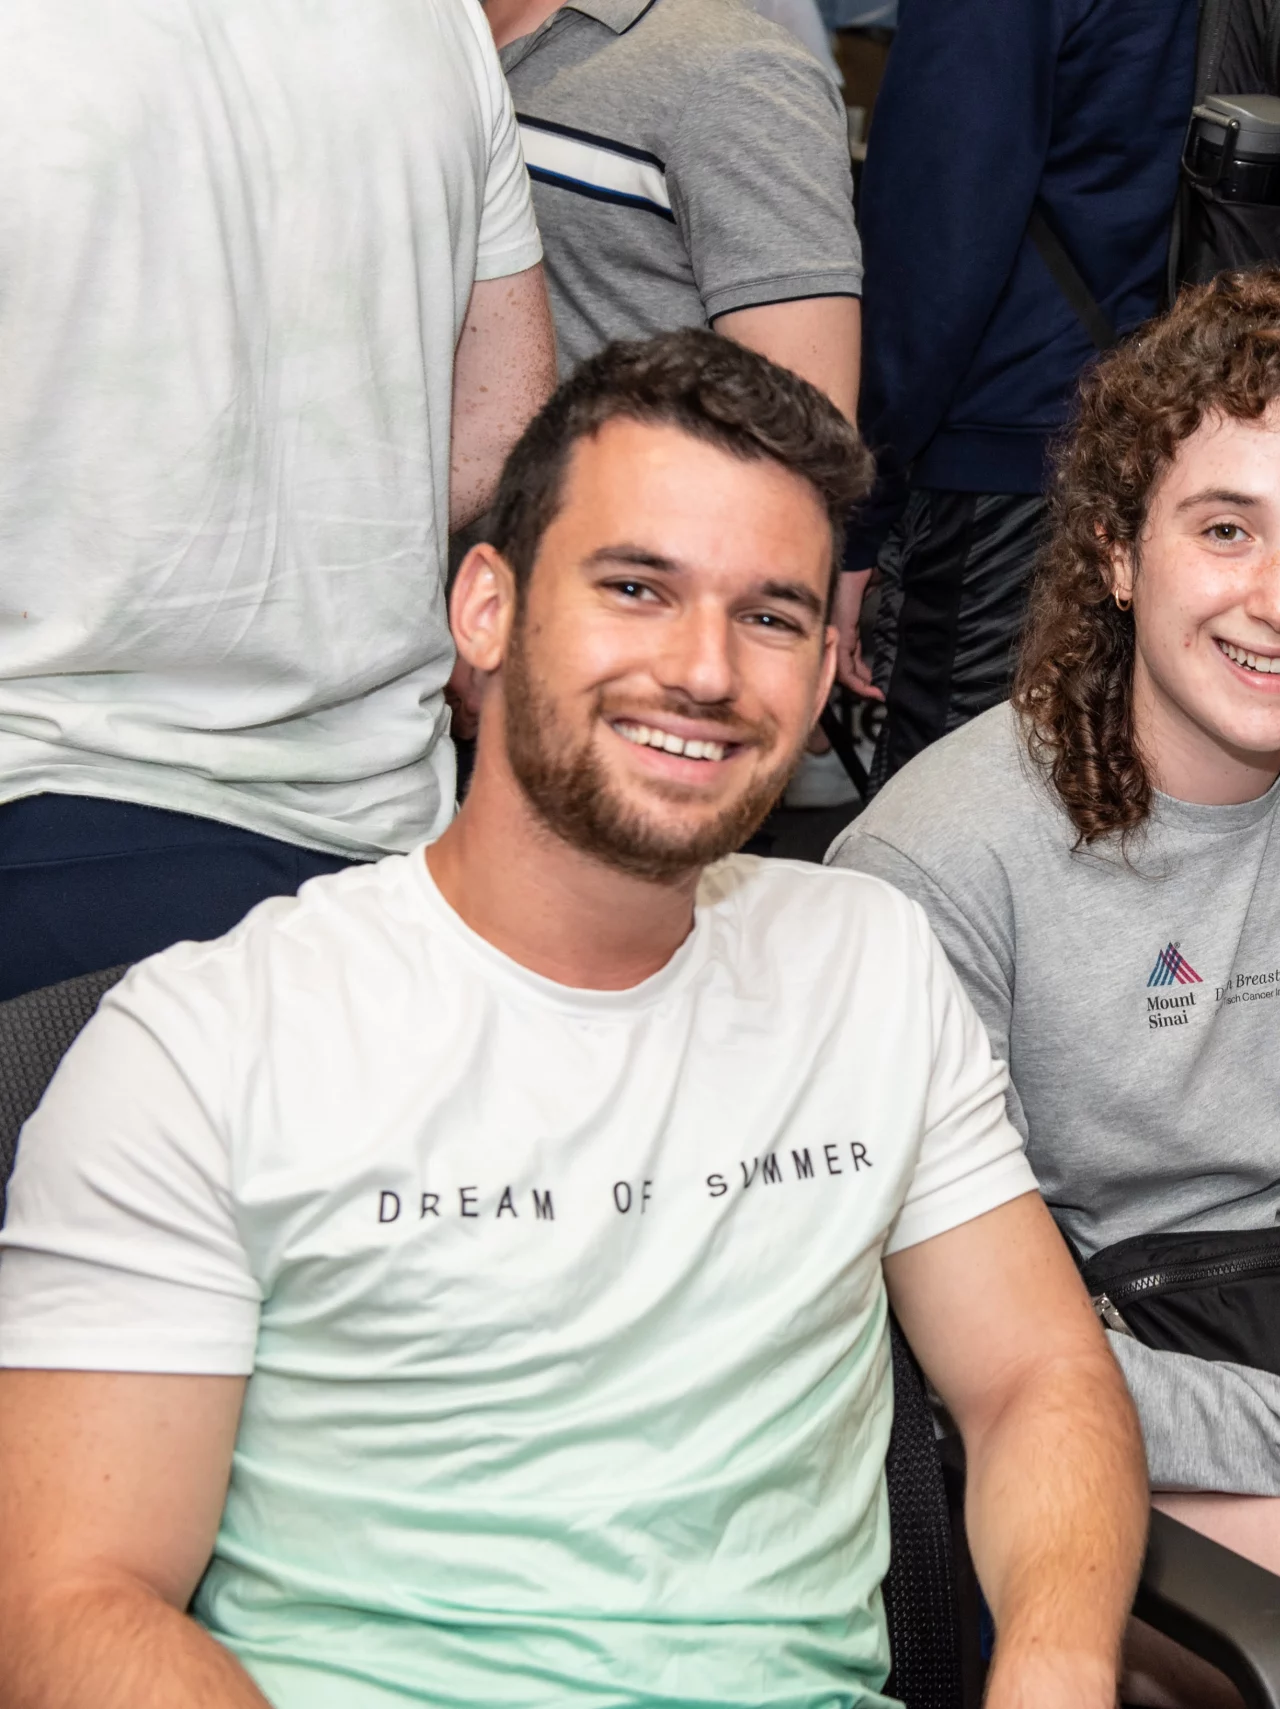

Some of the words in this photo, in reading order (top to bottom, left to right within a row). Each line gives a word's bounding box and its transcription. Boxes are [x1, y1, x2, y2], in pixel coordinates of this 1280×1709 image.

[1236, 968, 1280, 988] Breast
[1146, 991, 1197, 1012] Mount
[1242, 990, 1274, 1002] Cancer
[1148, 1010, 1190, 1029] Sinai
[377, 1185, 556, 1223] DREAM
[613, 1180, 653, 1215] OF
[706, 1141, 874, 1198] SUMMER
